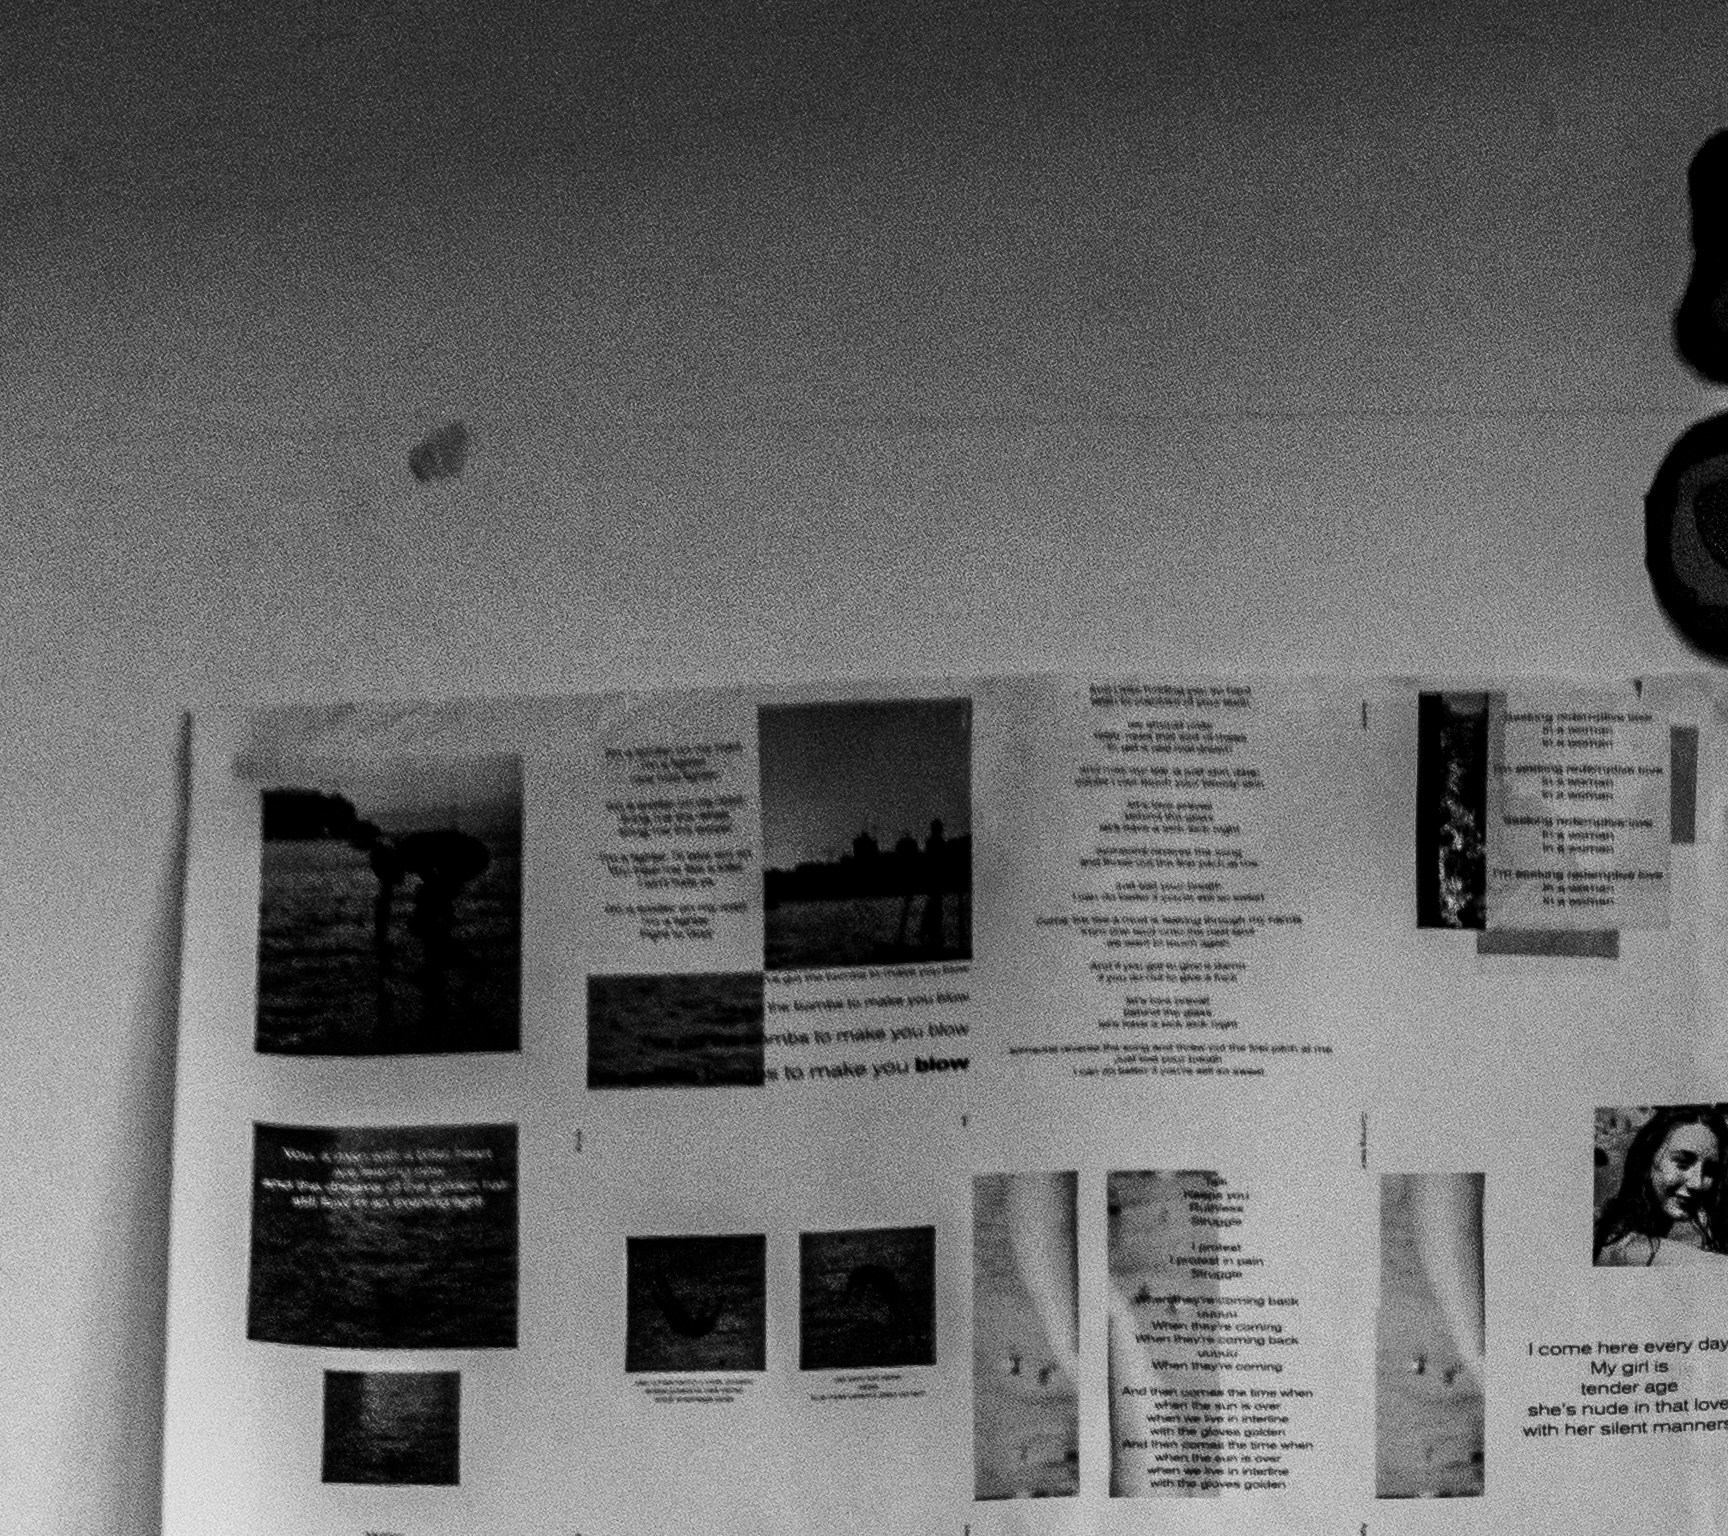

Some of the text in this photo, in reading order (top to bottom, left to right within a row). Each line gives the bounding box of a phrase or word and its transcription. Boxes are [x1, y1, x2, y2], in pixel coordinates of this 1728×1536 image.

[865, 995, 903, 1006] make
[908, 996, 932, 1006] you
[937, 992, 969, 1003] blow
[837, 1027, 885, 1041] make
[891, 1026, 922, 1041] you
[929, 1023, 969, 1036] blow
[810, 1062, 866, 1078] make
[873, 1061, 908, 1079] you
[915, 1057, 969, 1073] blow
[1228, 1192, 1249, 1200] you
[1191, 1216, 1242, 1226] Struggle
[1199, 1243, 1241, 1252] protest
[1176, 1256, 1219, 1266] protest
[1237, 1258, 1263, 1266] pain
[1191, 1269, 1242, 1279] Struggle
[1219, 1297, 1265, 1307] coming
[1268, 1297, 1299, 1306] back
[1152, 1321, 1187, 1331] When
[1236, 1323, 1282, 1332] coming
[1136, 1335, 1171, 1344] When
[1218, 1336, 1265, 1346] coming
[1268, 1336, 1299, 1345] back
[1528, 1337, 1728, 1356] I come here every day
[1152, 1361, 1187, 1371] When
[1236, 1363, 1282, 1373] coming
[1591, 1360, 1669, 1376] My girl is
[1122, 1388, 1313, 1397] And then comes the time when
[1581, 1381, 1677, 1395] tender age
[1155, 1401, 1187, 1410] when
[1192, 1402, 1211, 1410] the
[1528, 1398, 1728, 1417] she's nude in that love
[1147, 1414, 1180, 1423] when
[1151, 1428, 1175, 1436] with
[1244, 1428, 1285, 1437] golden
[1523, 1423, 1558, 1437] with
[1565, 1423, 1593, 1435] her
[1600, 1421, 1647, 1435] silent
[1123, 1440, 1147, 1449] And
[1151, 1440, 1177, 1449] then
[1228, 1441, 1246, 1449] the
[1251, 1440, 1277, 1449] time
[1281, 1441, 1313, 1449] when
[1155, 1454, 1188, 1462] when
[1192, 1454, 1211, 1462] the
[1151, 1480, 1175, 1488] with
[1178, 1480, 1196, 1488] the
[1244, 1481, 1286, 1490] golden
